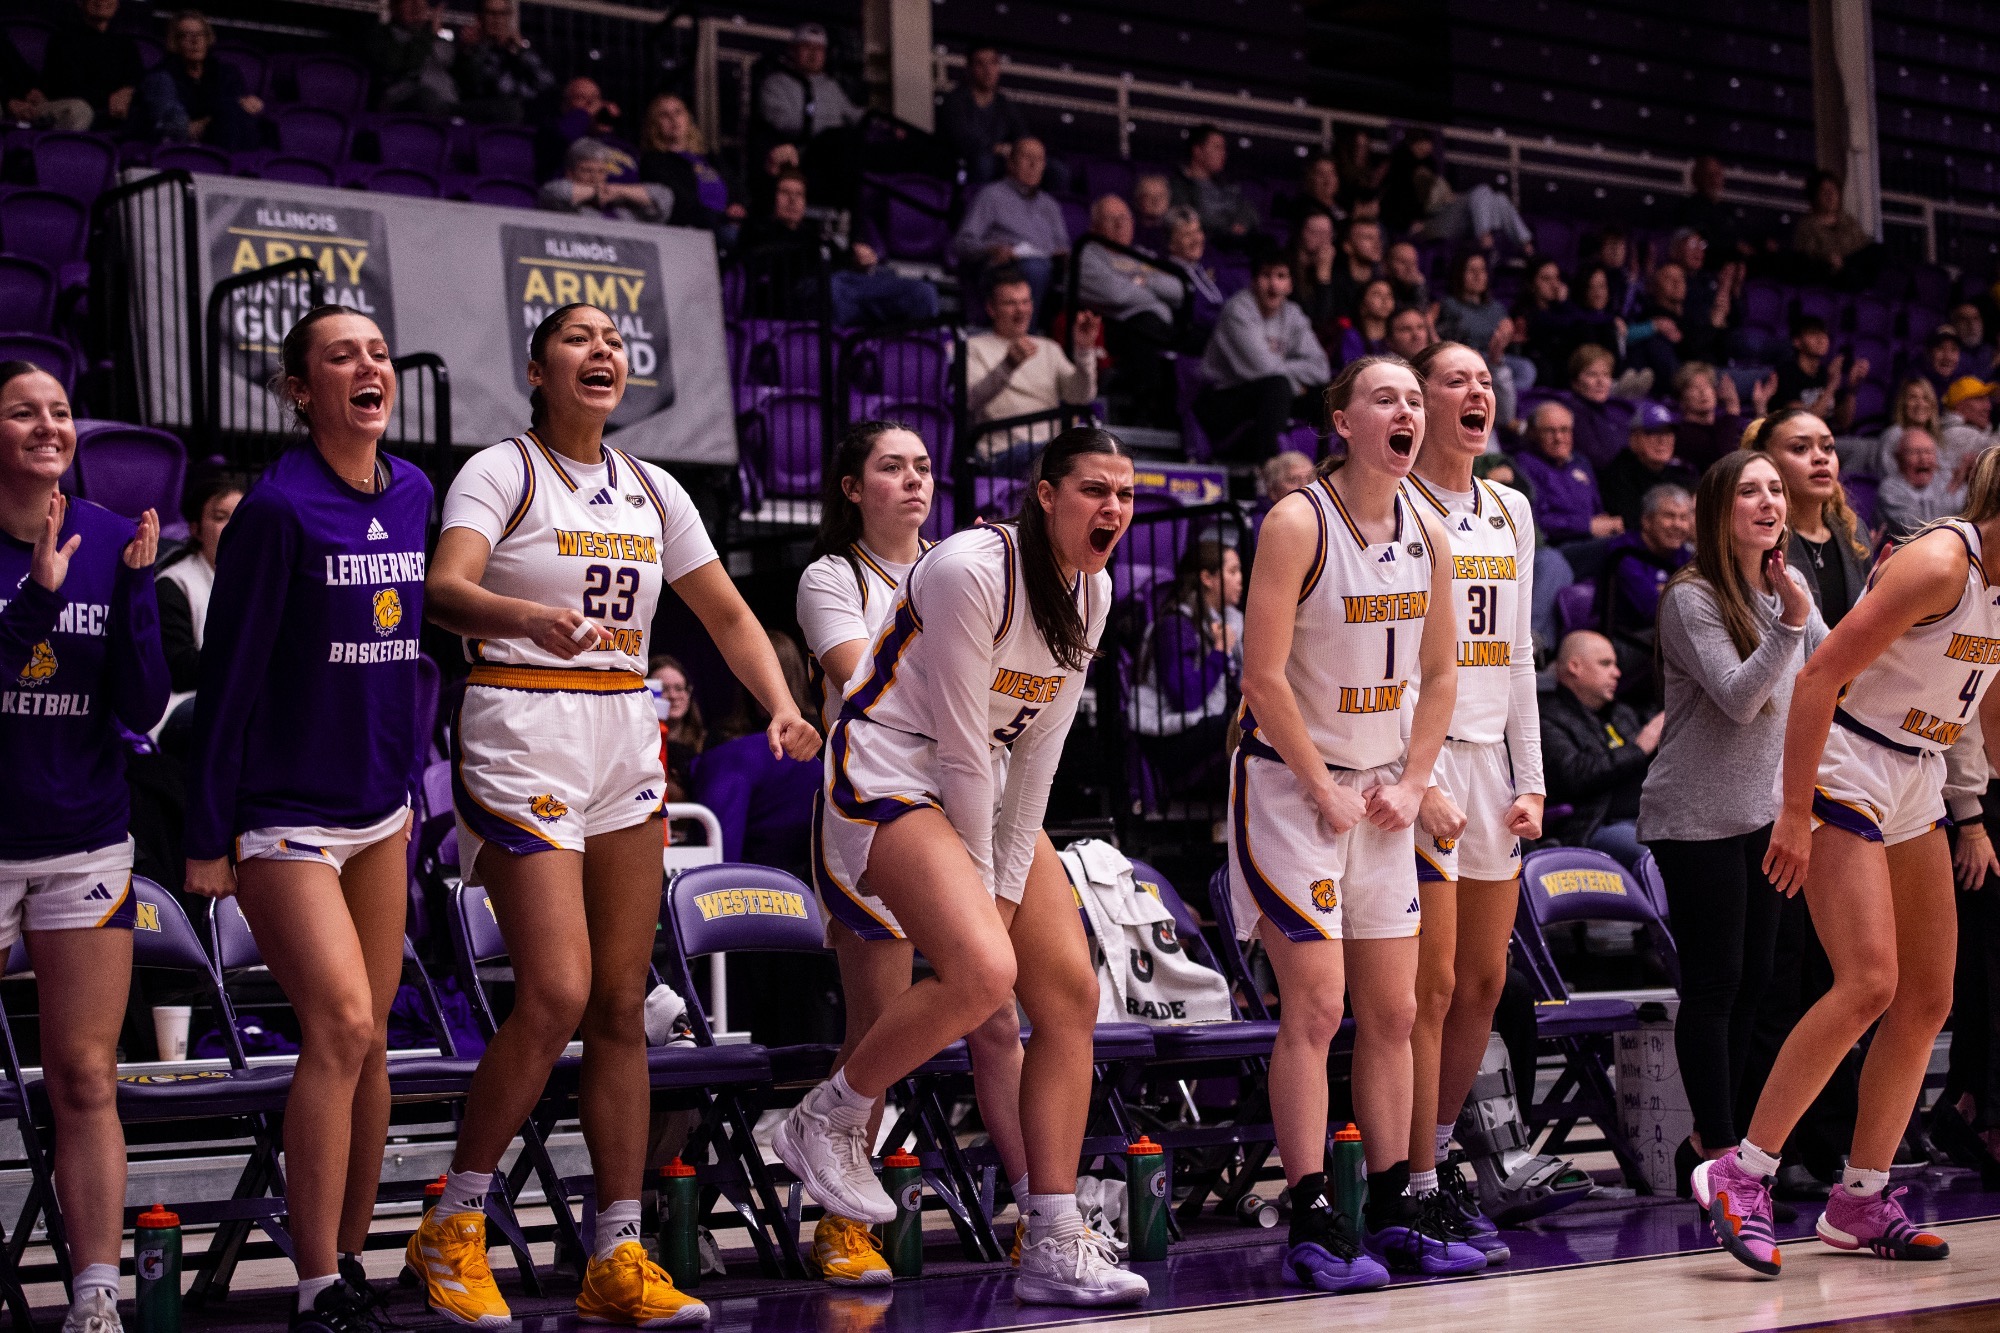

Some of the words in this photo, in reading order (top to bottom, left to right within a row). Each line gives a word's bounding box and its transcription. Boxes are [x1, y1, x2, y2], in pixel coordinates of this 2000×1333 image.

[256, 208, 338, 232] ILLINOIS
[545, 238, 618, 262] ILLINOIS
[523, 267, 645, 313] ARMY
[366, 531, 389, 541] adidas
[553, 528, 657, 564] WESTERN
[325, 551, 426, 586] LEATHERNEC
[1452, 555, 1517, 581] ESTERN
[582, 564, 640, 622] 23
[1341, 590, 1429, 624] WESTERN
[1468, 585, 1498, 635] 31
[1384, 627, 1396, 680] 1
[0, 690, 90, 716] KETBALL
[1958, 669, 1985, 719] 4
[993, 705, 1041, 743] 5
[1539, 868, 1628, 897] WESTERN
[693, 887, 809, 922] WESTERN
[1126, 997, 1187, 1021] RADE
